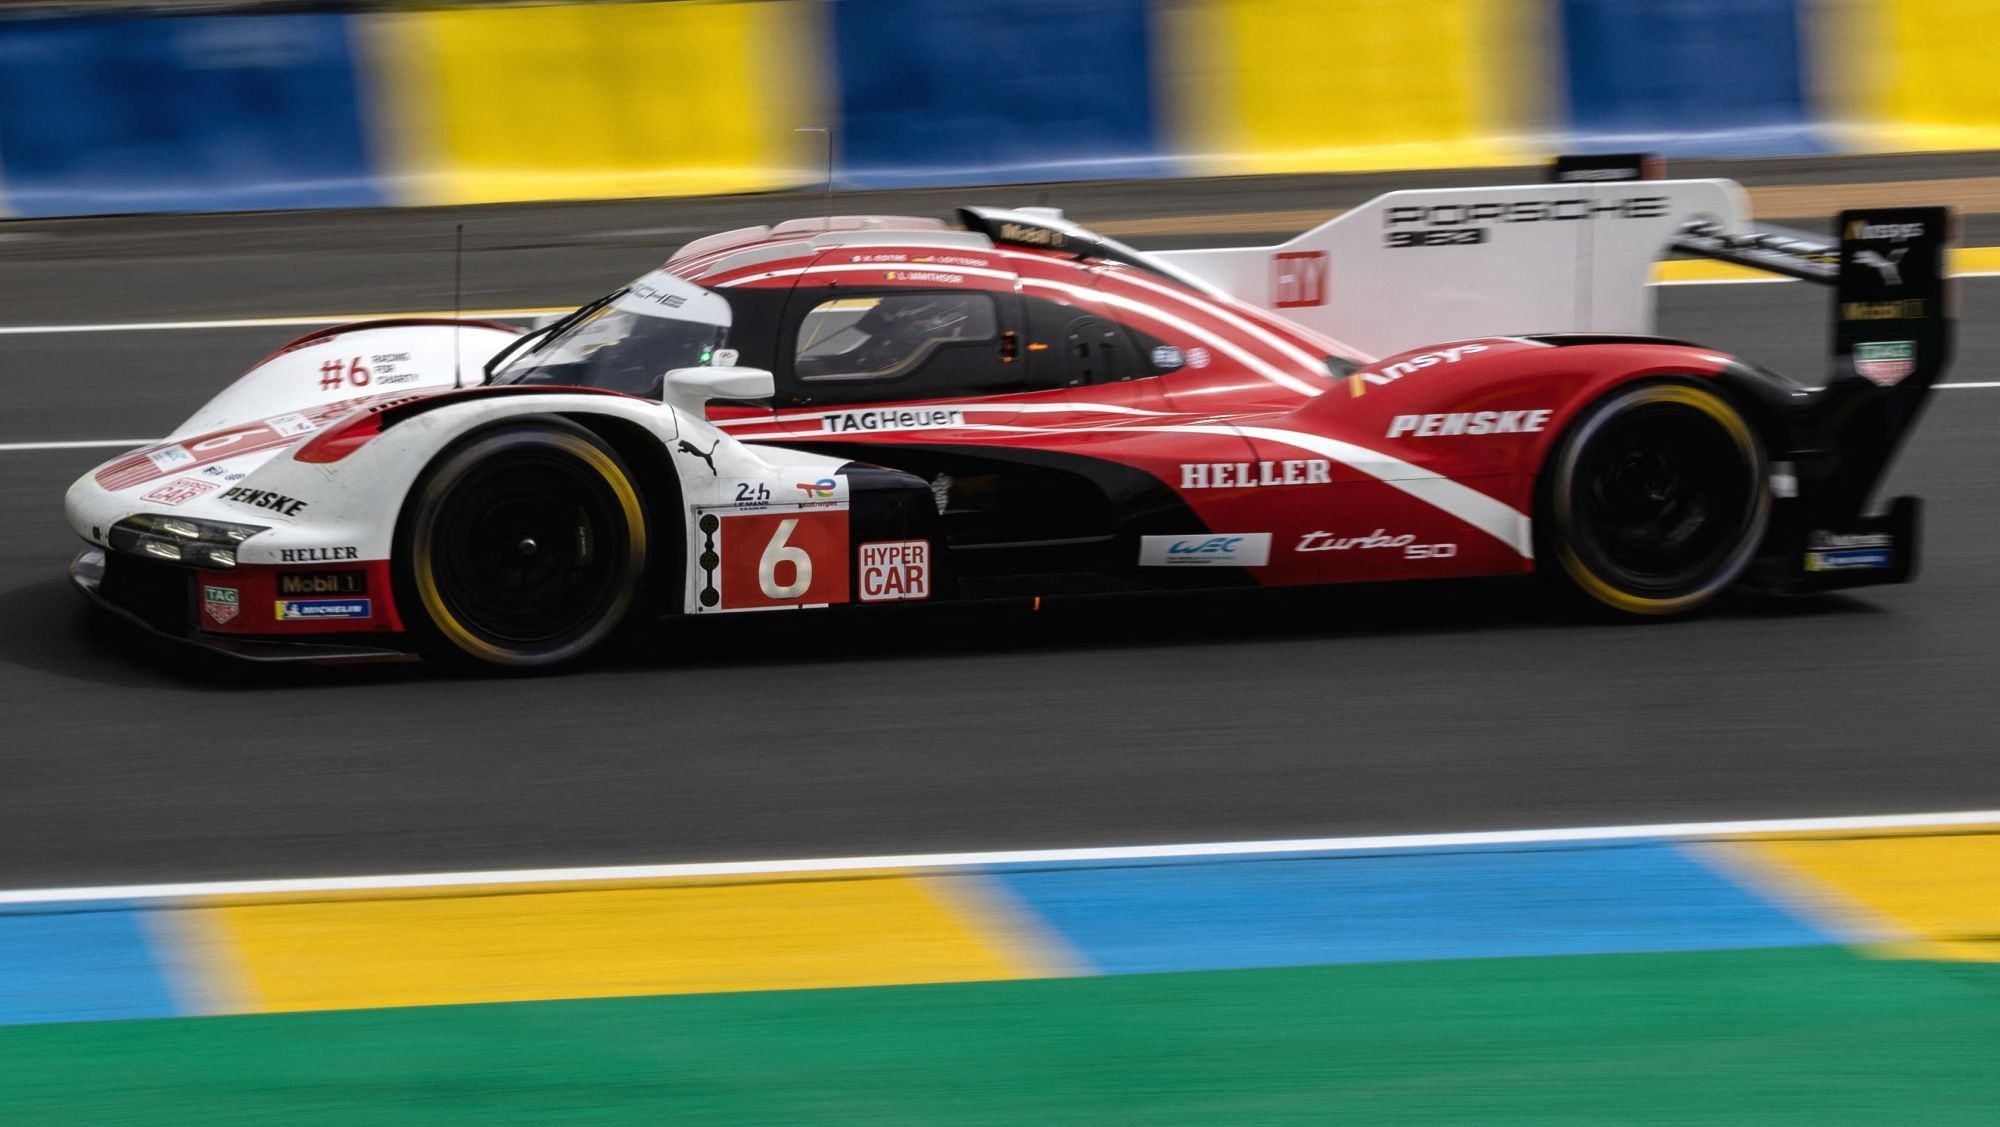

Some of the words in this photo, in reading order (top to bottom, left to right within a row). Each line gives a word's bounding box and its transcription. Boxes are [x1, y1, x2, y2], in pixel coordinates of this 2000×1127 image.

[1382, 197, 1669, 227] PORSCHE
[319, 356, 371, 391] #6
[1349, 344, 1489, 398] Ansys
[1385, 410, 1553, 438] PENSKE
[1180, 460, 1332, 489] HELLER
[218, 486, 308, 517] PENSKE
[1168, 537, 1244, 553] WEC
[1294, 528, 1416, 551] turbo
[1403, 543, 1457, 559] 50
[281, 546, 358, 562] HELLER
[759, 519, 812, 599] 6
[864, 546, 924, 566] HYPER
[282, 575, 339, 592] Mobil
[864, 566, 924, 596] CAR
[207, 589, 235, 602] TAG
[302, 605, 363, 614] MICHELIN
